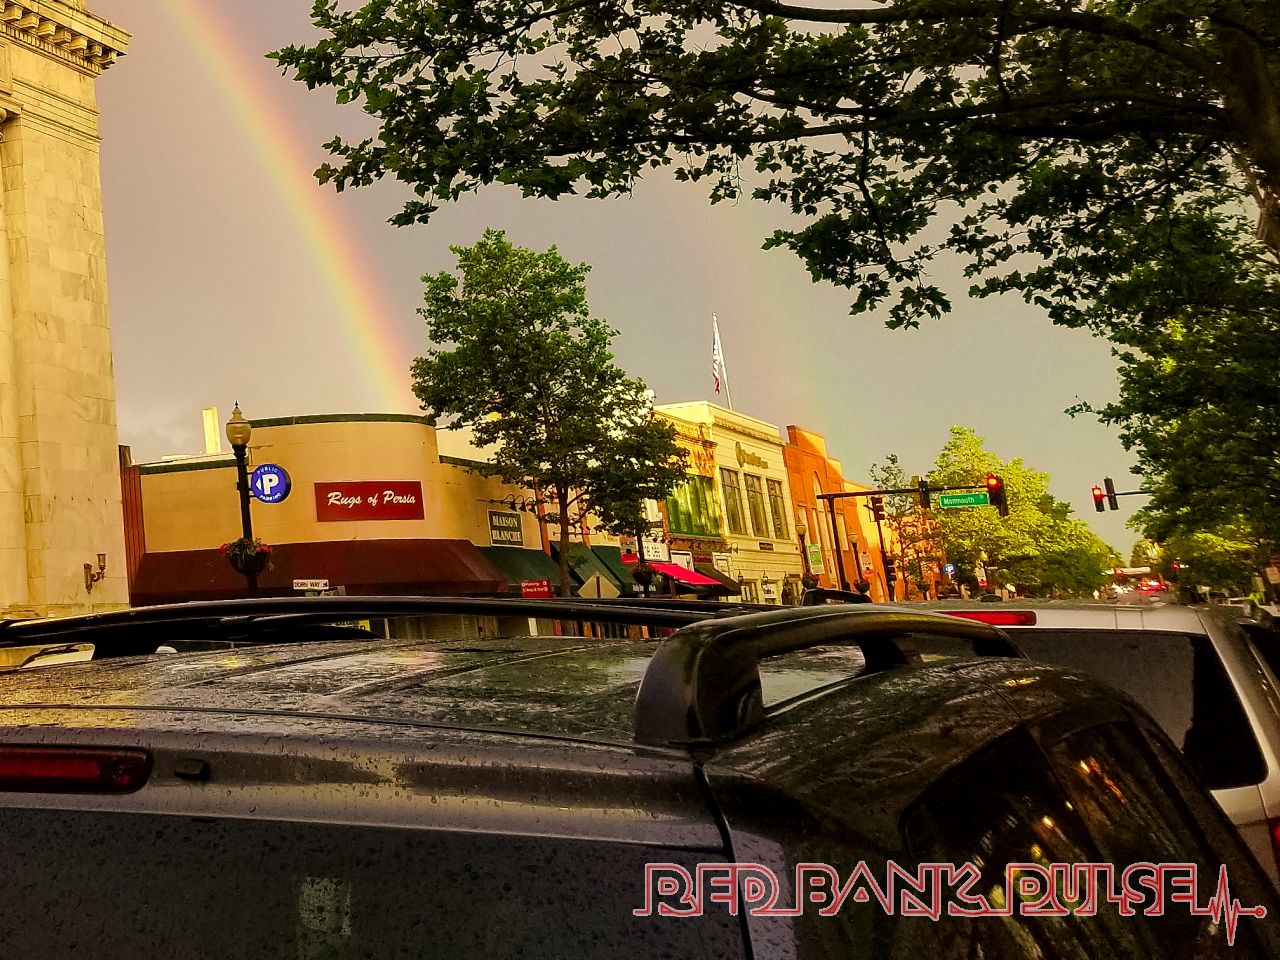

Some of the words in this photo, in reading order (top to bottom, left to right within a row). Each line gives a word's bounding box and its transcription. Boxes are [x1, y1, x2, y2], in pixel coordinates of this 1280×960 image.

[257, 466, 278, 475] PUBLIC
[262, 474, 279, 495] P
[260, 492, 282, 501] PARKING
[327, 491, 363, 508] Rugs
[367, 492, 378, 506] of
[382, 490, 416, 504] Persia
